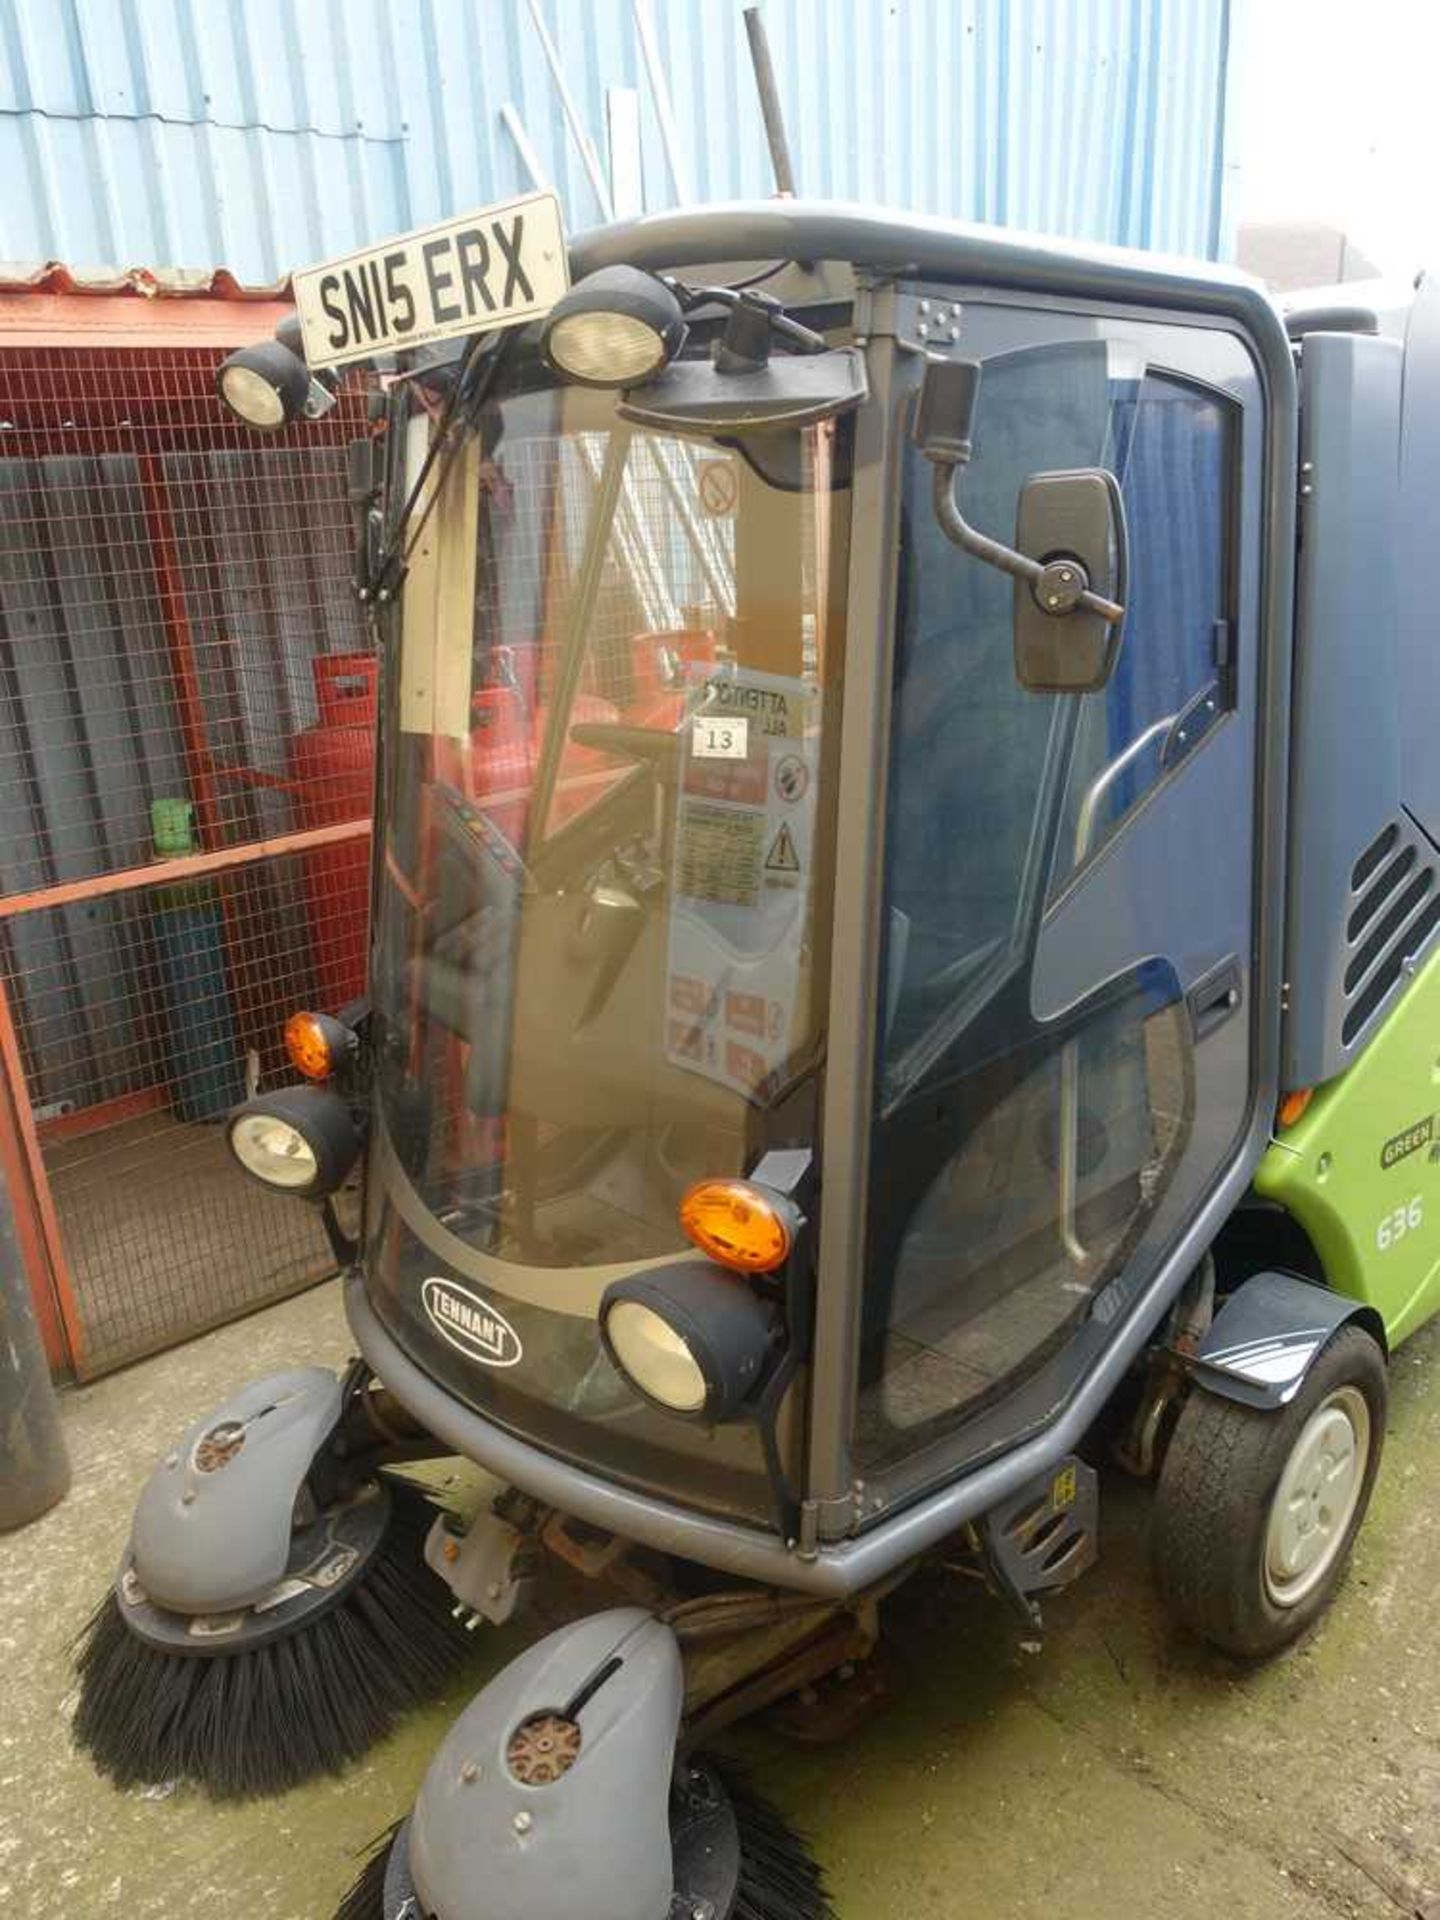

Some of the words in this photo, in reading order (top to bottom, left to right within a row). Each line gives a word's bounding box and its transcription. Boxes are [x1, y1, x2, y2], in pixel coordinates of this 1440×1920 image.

[319, 250, 416, 350] SN15
[422, 215, 535, 325] ERX
[706, 729, 733, 750] 13
[1383, 1123, 1430, 1165] GREEN
[1376, 1195, 1423, 1250] 636
[431, 1285, 507, 1357] TENNANT
